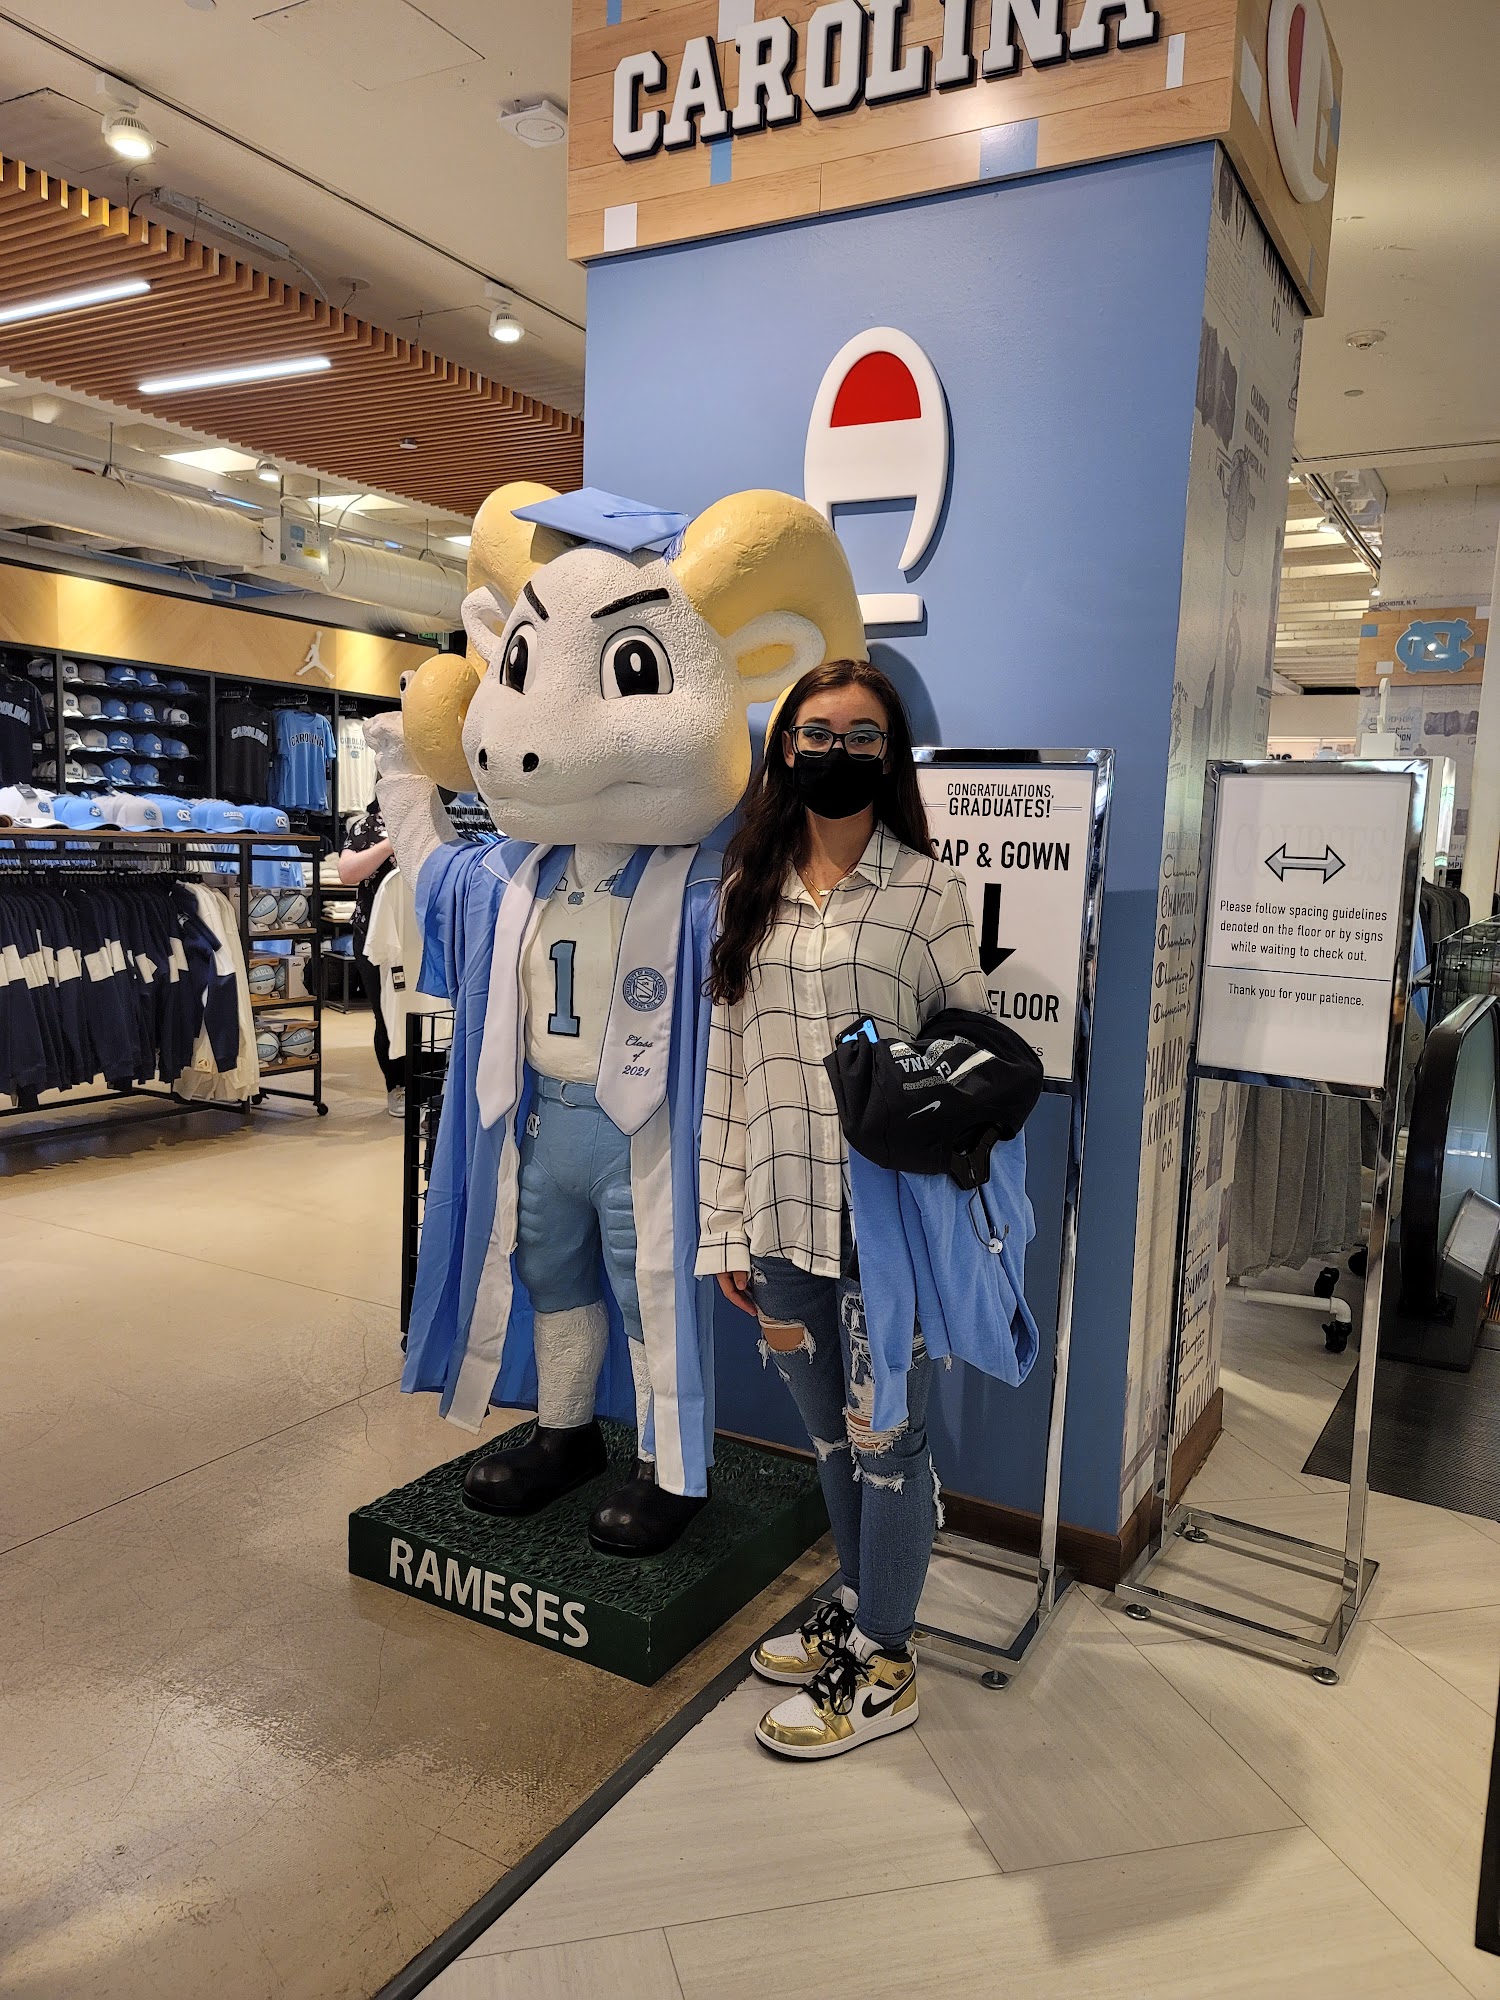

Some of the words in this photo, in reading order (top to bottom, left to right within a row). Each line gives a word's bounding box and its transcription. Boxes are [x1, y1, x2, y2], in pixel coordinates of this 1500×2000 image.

[0, 701, 30, 726] OLINA
[291, 732, 325, 748] CAROLINA
[947, 783, 1054, 799] CONGRATULATIONS,
[949, 797, 1051, 818] GRADUATES!
[976, 842, 992, 868] &
[1001, 841, 1070, 871] GOWN
[1220, 900, 1252, 913] Please
[1255, 902, 1286, 915] follow
[1289, 905, 1329, 920] spacing
[1332, 907, 1387, 921] guidelines
[1220, 920, 1259, 933] denoted
[1262, 925, 1274, 934] on
[1278, 924, 1294, 936] the
[1297, 925, 1322, 938] floor
[1325, 929, 1336, 938] or
[1339, 928, 1351, 942] by
[1355, 930, 1383, 944] signs
[1231, 941, 1257, 953] while
[1260, 943, 1296, 958] waiting
[1300, 945, 1309, 957] to
[1313, 948, 1344, 960] check
[1347, 952, 1367, 962] out.
[548, 939, 581, 1037] 1
[1228, 983, 1256, 996] Thank
[1259, 988, 1276, 1000] you
[1279, 987, 1293, 999] for
[1295, 991, 1317, 1003] your
[1319, 992, 1364, 1007] patience.
[625, 1034, 653, 1048] Class
[632, 1049, 645, 1062] of
[622, 1064, 651, 1077] 2021
[389, 1537, 589, 1648] RAMESES
